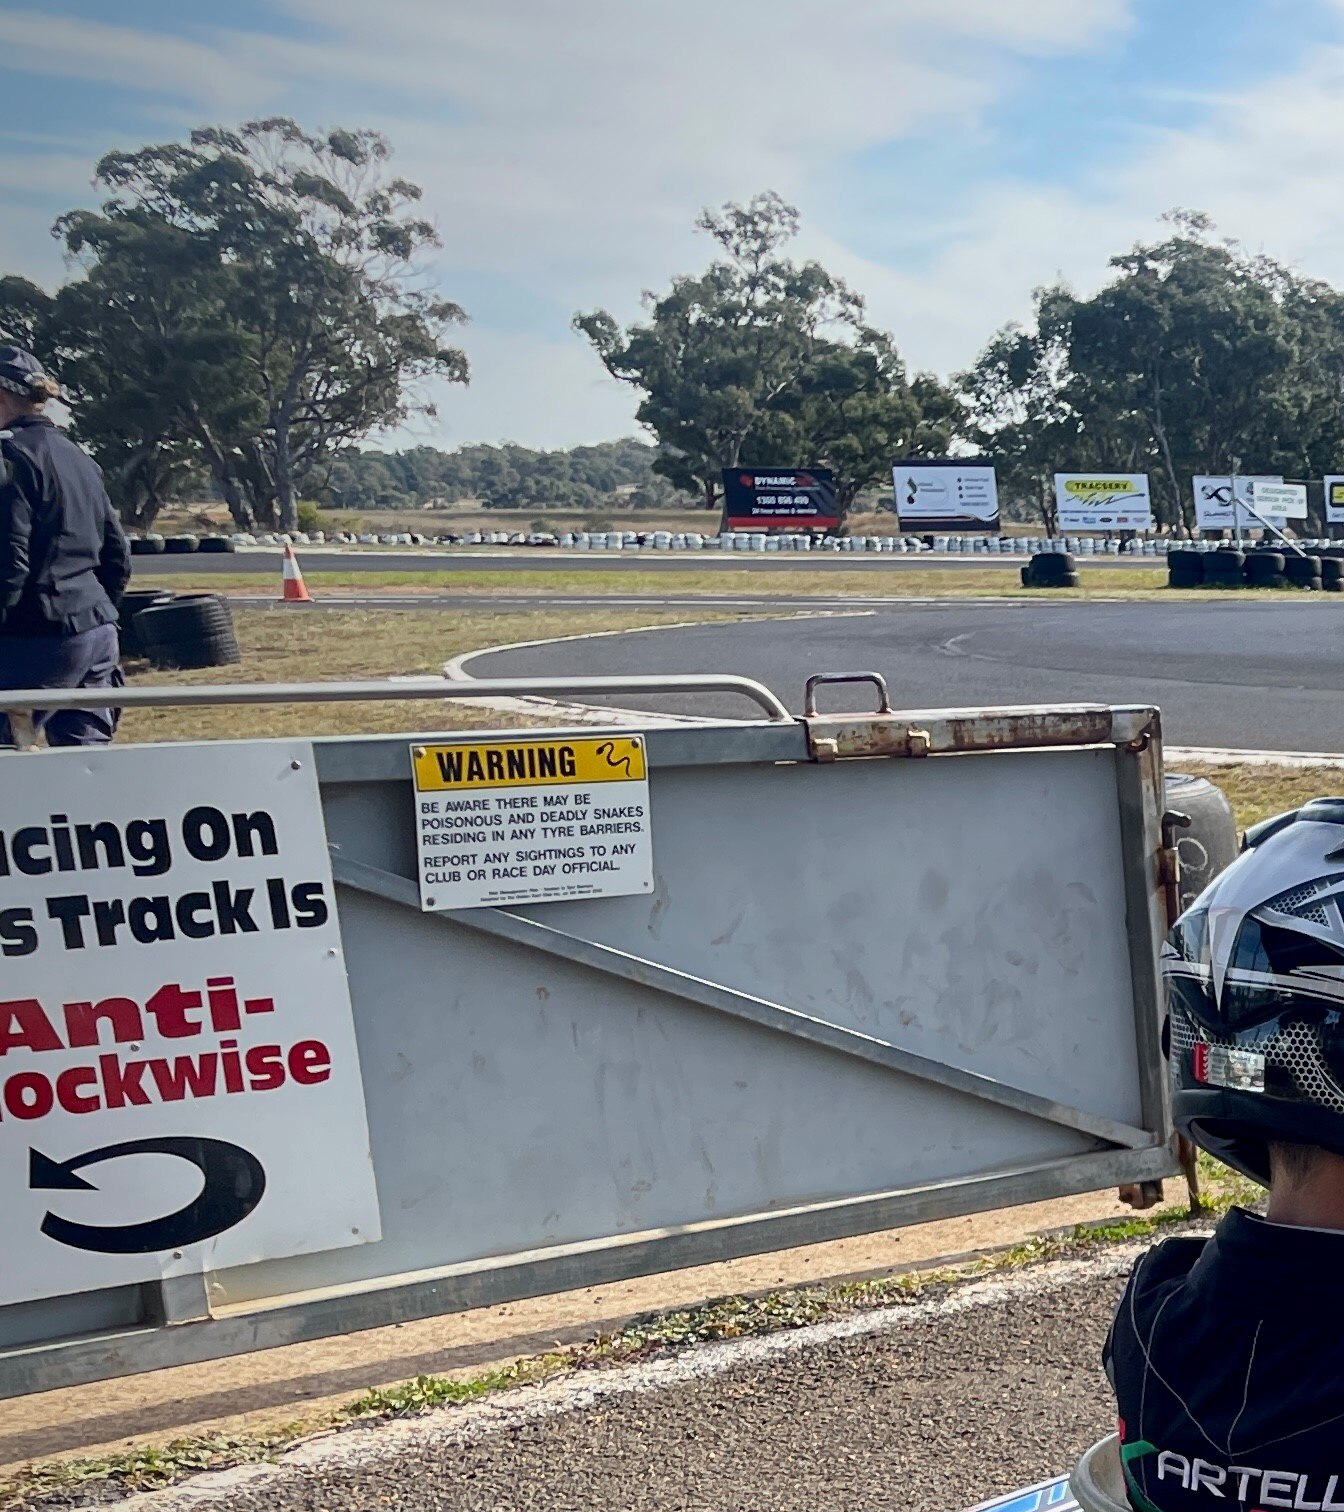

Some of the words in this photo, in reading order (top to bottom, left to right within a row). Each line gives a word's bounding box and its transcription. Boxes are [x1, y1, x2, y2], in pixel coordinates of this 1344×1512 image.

[436, 746, 576, 783] WARNING
[421, 802, 439, 814] BE
[446, 799, 490, 813] AWARE
[497, 797, 537, 809] THERE
[544, 795, 570, 806] MAY
[575, 794, 591, 805] BE
[422, 815, 502, 830] POISONOUS
[508, 813, 535, 825] AND
[541, 809, 587, 823] DEADLY
[593, 806, 643, 819] SNAKES
[0, 814, 172, 878] cing
[182, 805, 278, 864] On
[423, 831, 487, 846] RESIDING
[492, 829, 505, 841] IN
[510, 828, 536, 840] ANY
[542, 826, 574, 839] TYRE
[580, 822, 644, 835] BARRIERS.
[424, 854, 477, 867] REPORT
[484, 852, 510, 865] ANY
[516, 848, 585, 862] SIGHTINGS
[590, 846, 607, 857] TO
[612, 844, 636, 856] ANY
[425, 870, 462, 884] CLUB
[467, 869, 486, 881] OR
[492, 867, 528, 879] RACE
[533, 864, 557, 876] DAY
[45, 880, 260, 950] Track
[266, 877, 329, 930] Is
[0, 977, 275, 1055] Anti-
[0, 1038, 331, 1123] ockwise
